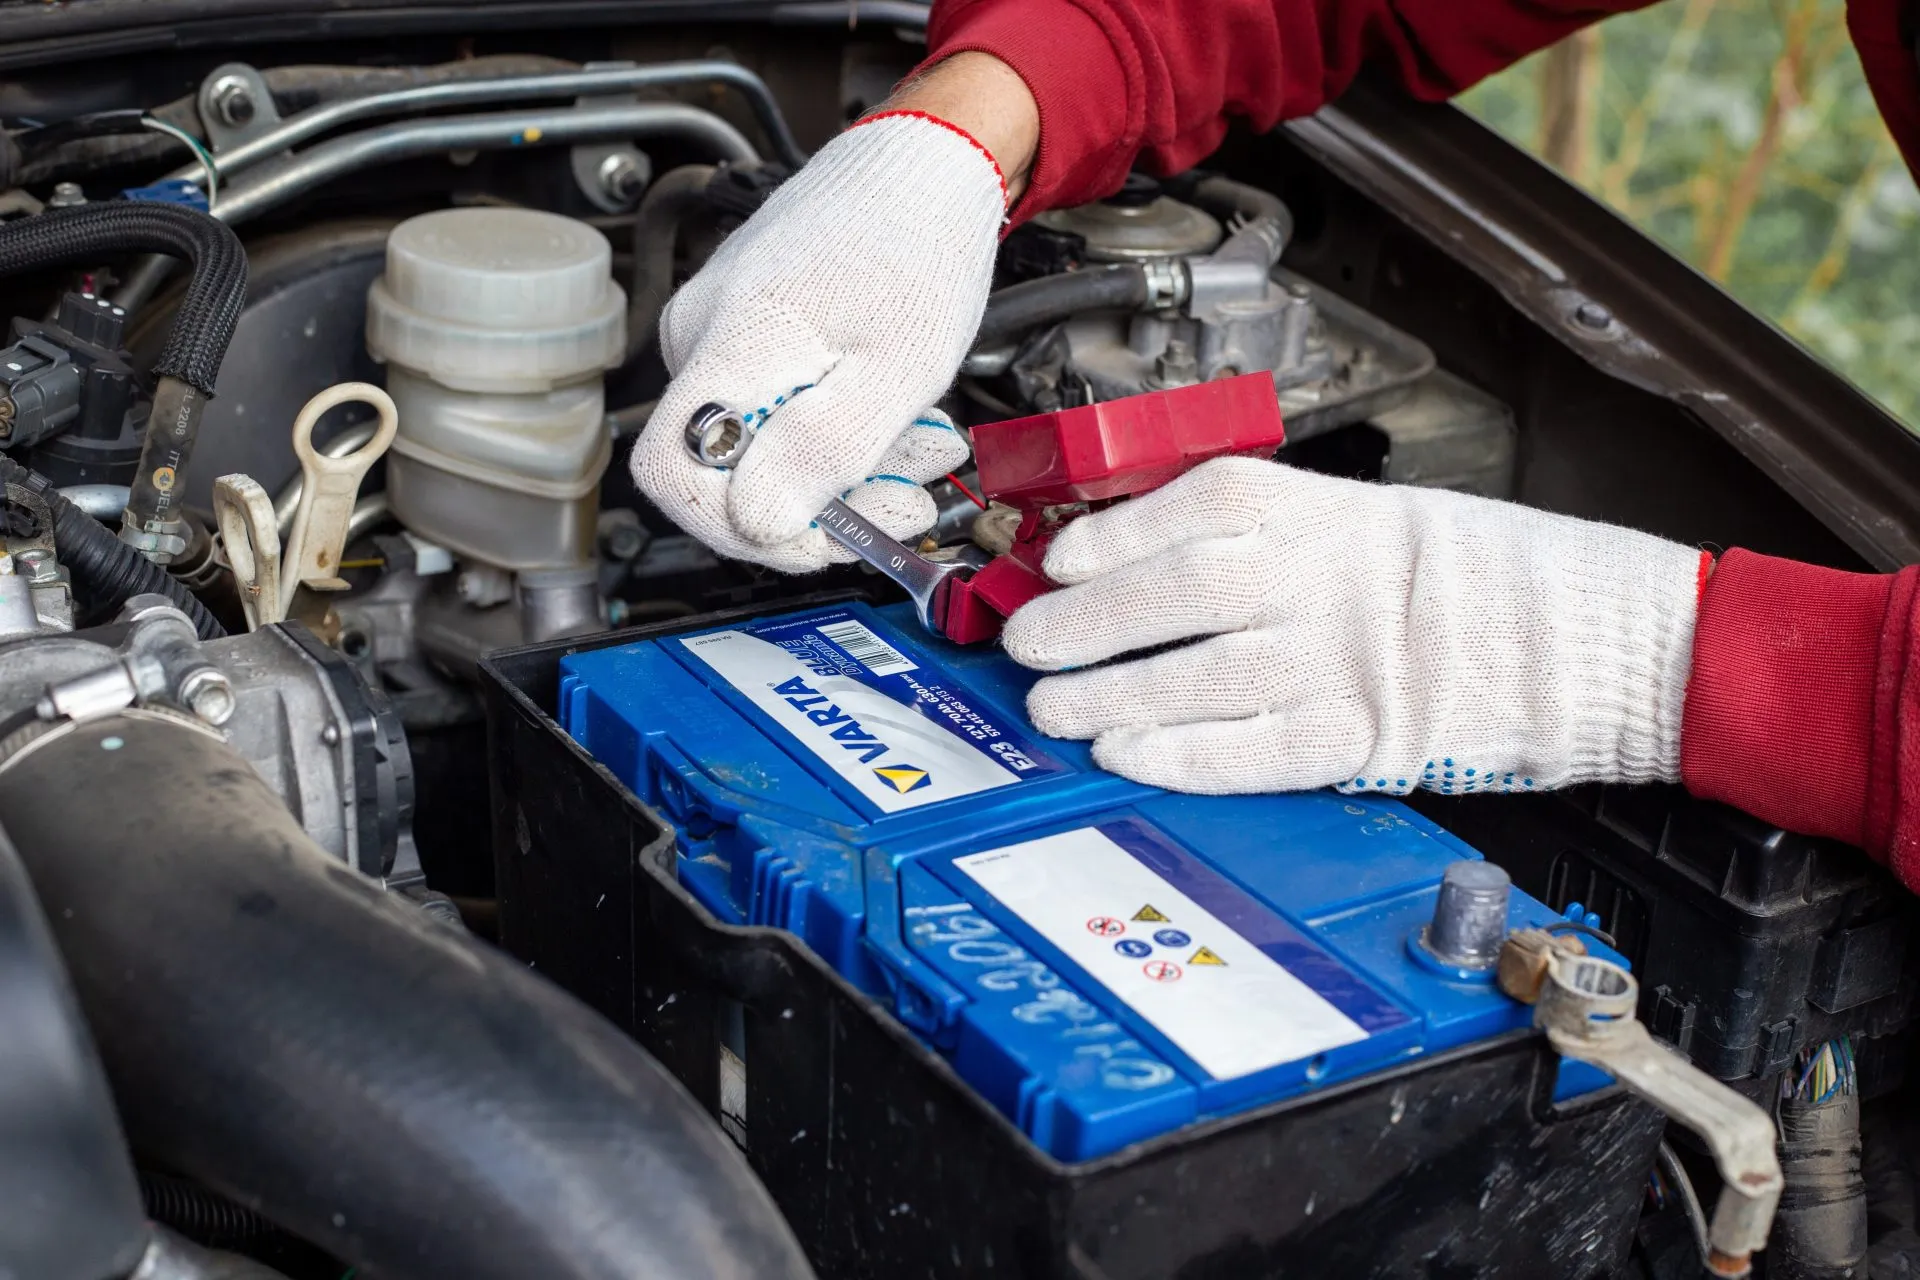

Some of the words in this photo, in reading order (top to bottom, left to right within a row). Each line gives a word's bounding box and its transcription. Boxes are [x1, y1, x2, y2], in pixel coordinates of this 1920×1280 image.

[175, 407, 191, 436] 2208
[890, 556, 906, 571] 10
[776, 640, 842, 676] BLUE
[803, 634, 863, 676] Dynamic
[936, 690, 955, 702] 313
[938, 703, 967, 723] 70Ah
[951, 701, 970, 713] 063
[772, 676, 890, 764] VARTA
[967, 712, 984, 725] 412
[962, 724, 988, 740] 12V
[981, 724, 1001, 737] 570
[990, 741, 1039, 771] E23
